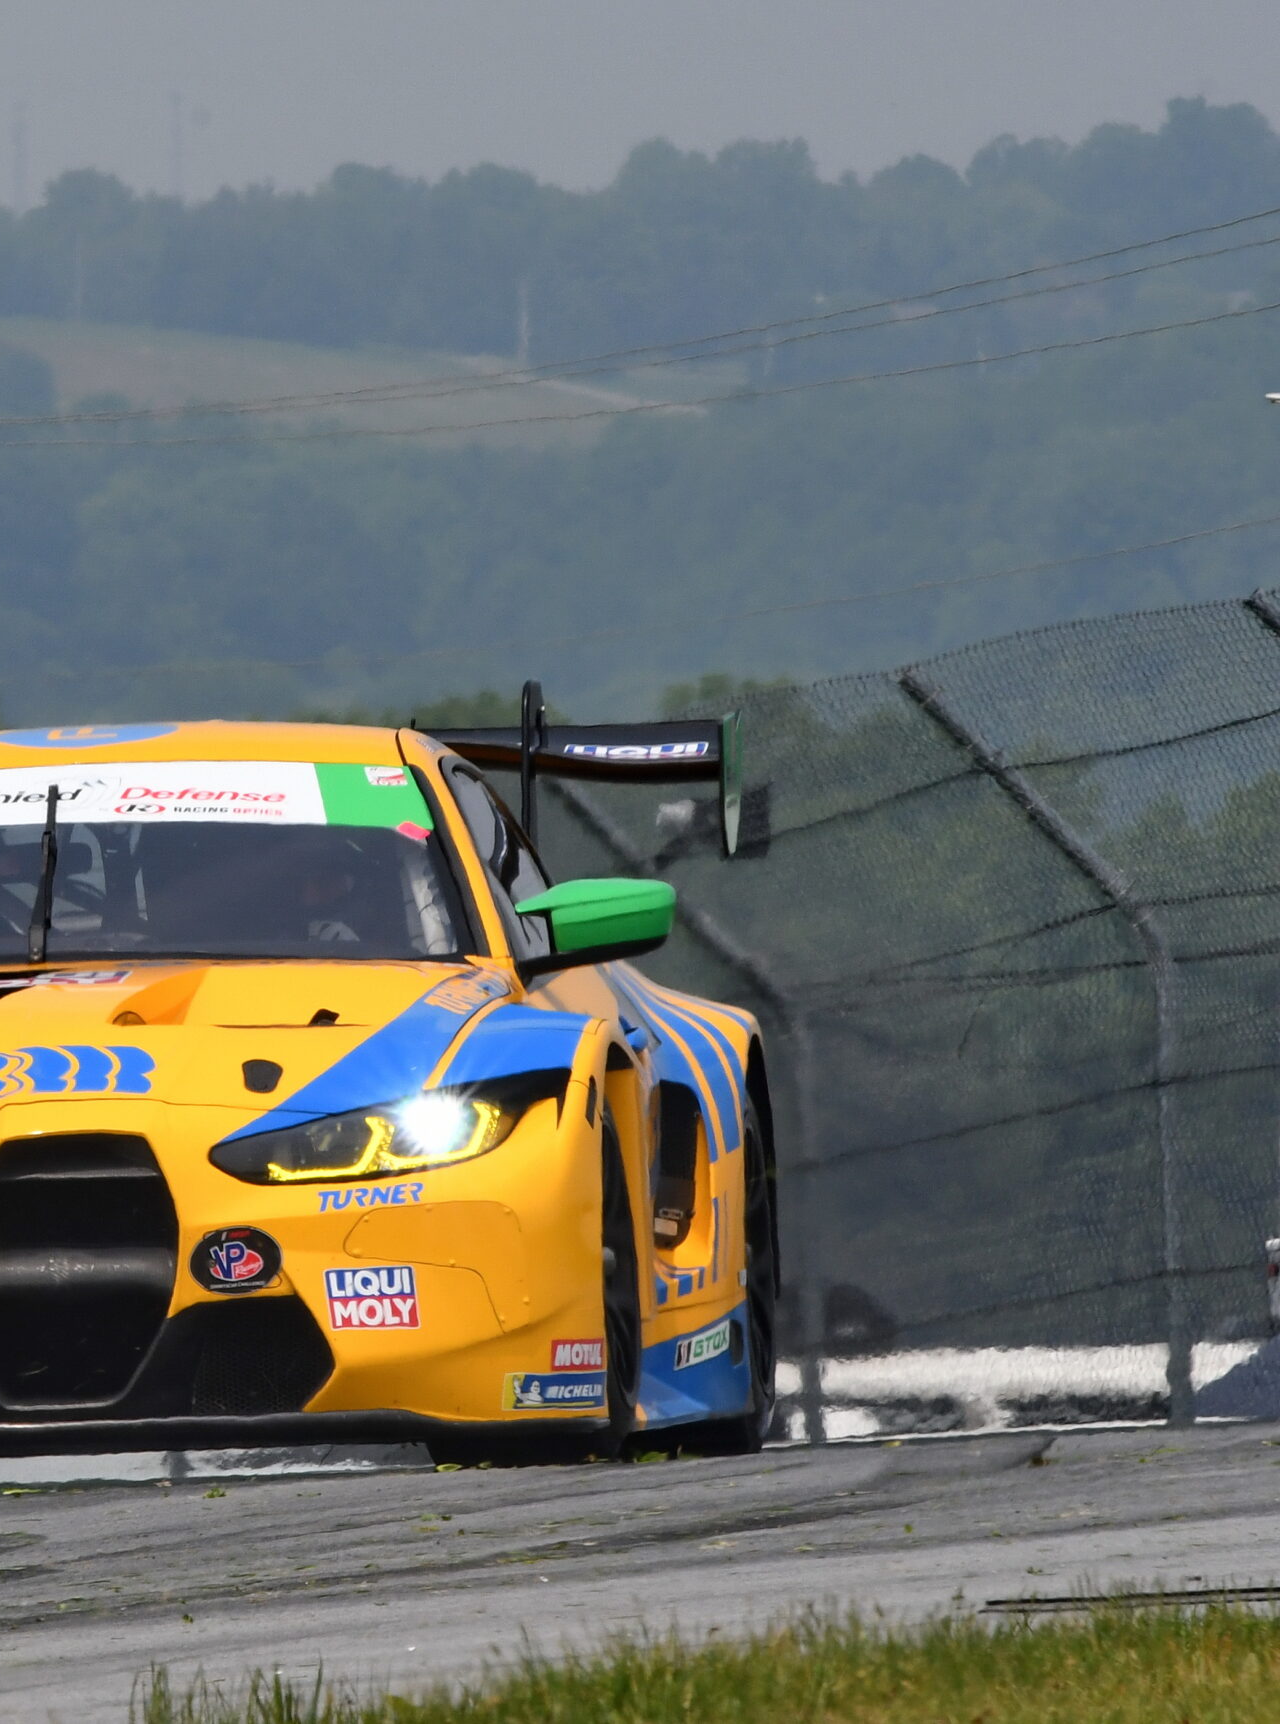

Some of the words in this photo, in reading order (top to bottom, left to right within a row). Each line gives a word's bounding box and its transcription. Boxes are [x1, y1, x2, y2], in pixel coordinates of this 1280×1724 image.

[120, 786, 286, 803] Defense
[173, 806, 229, 814] RACING
[318, 1182, 423, 1212] TURNER
[210, 1242, 247, 1280] VP
[329, 1268, 411, 1297] LIQUI
[333, 1298, 414, 1326] MOLY
[554, 1343, 601, 1366] MOTUL
[545, 1384, 602, 1399] MICHELIN
